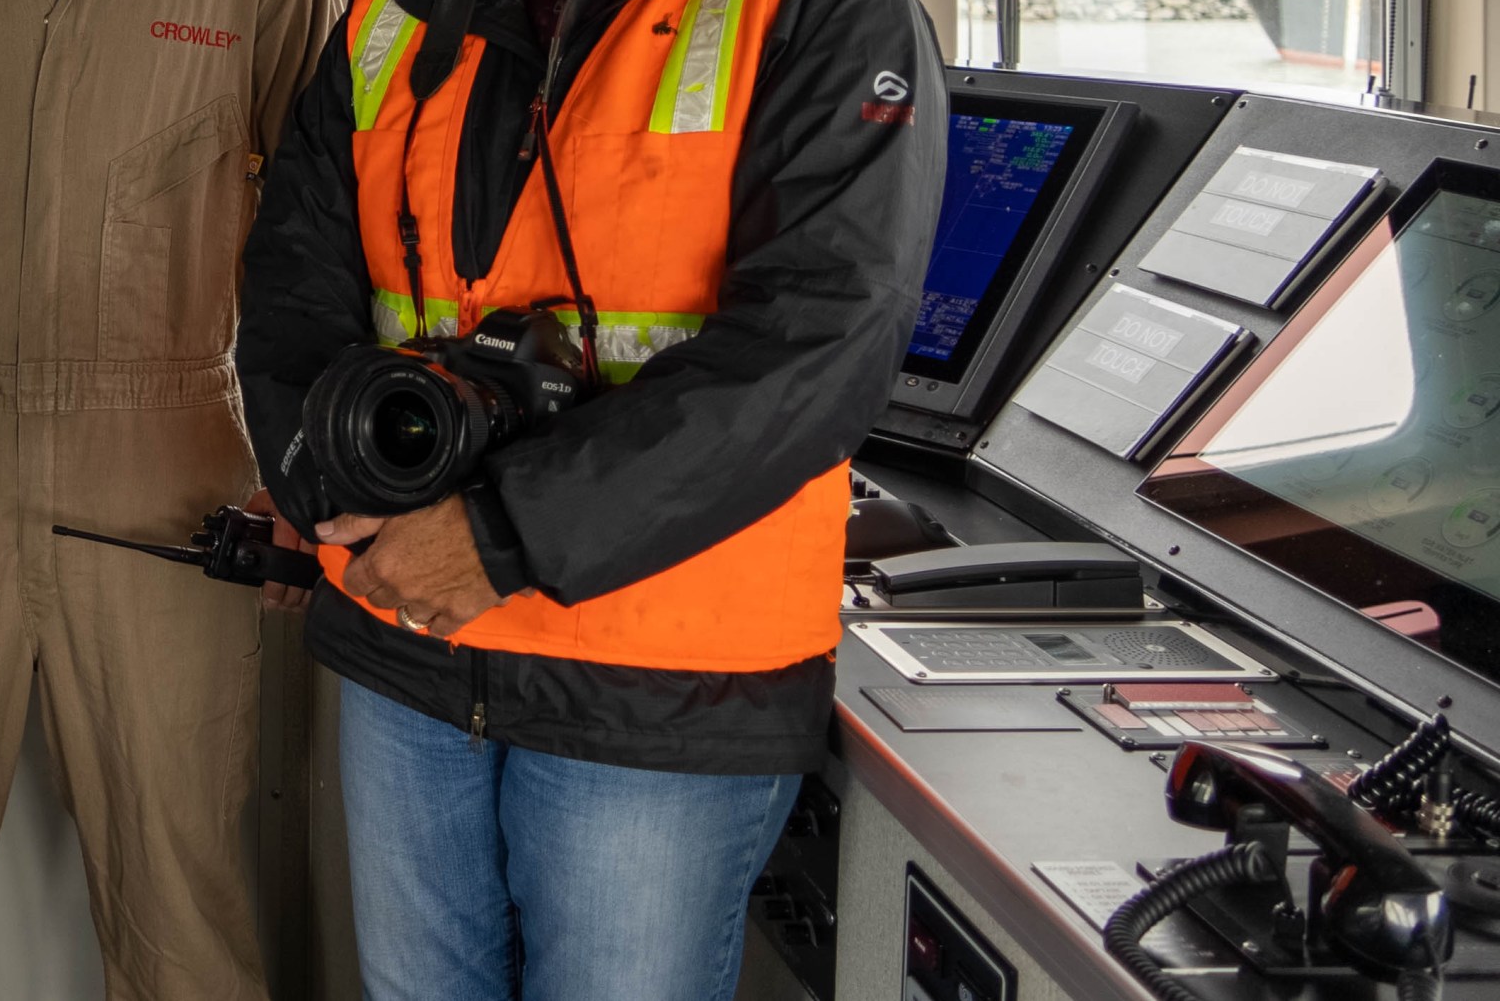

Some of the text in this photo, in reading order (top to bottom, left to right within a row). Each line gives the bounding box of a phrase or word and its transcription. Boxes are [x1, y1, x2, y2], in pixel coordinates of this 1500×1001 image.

[150, 20, 236, 51] CROWLEY
[1267, 180, 1309, 204] NOT
[1217, 204, 1281, 233] TOUCH
[474, 333, 516, 352] Canon
[1112, 316, 1180, 357] DO NOT
[1092, 343, 1151, 377] TOUCH
[280, 428, 306, 473] GORE-TE
